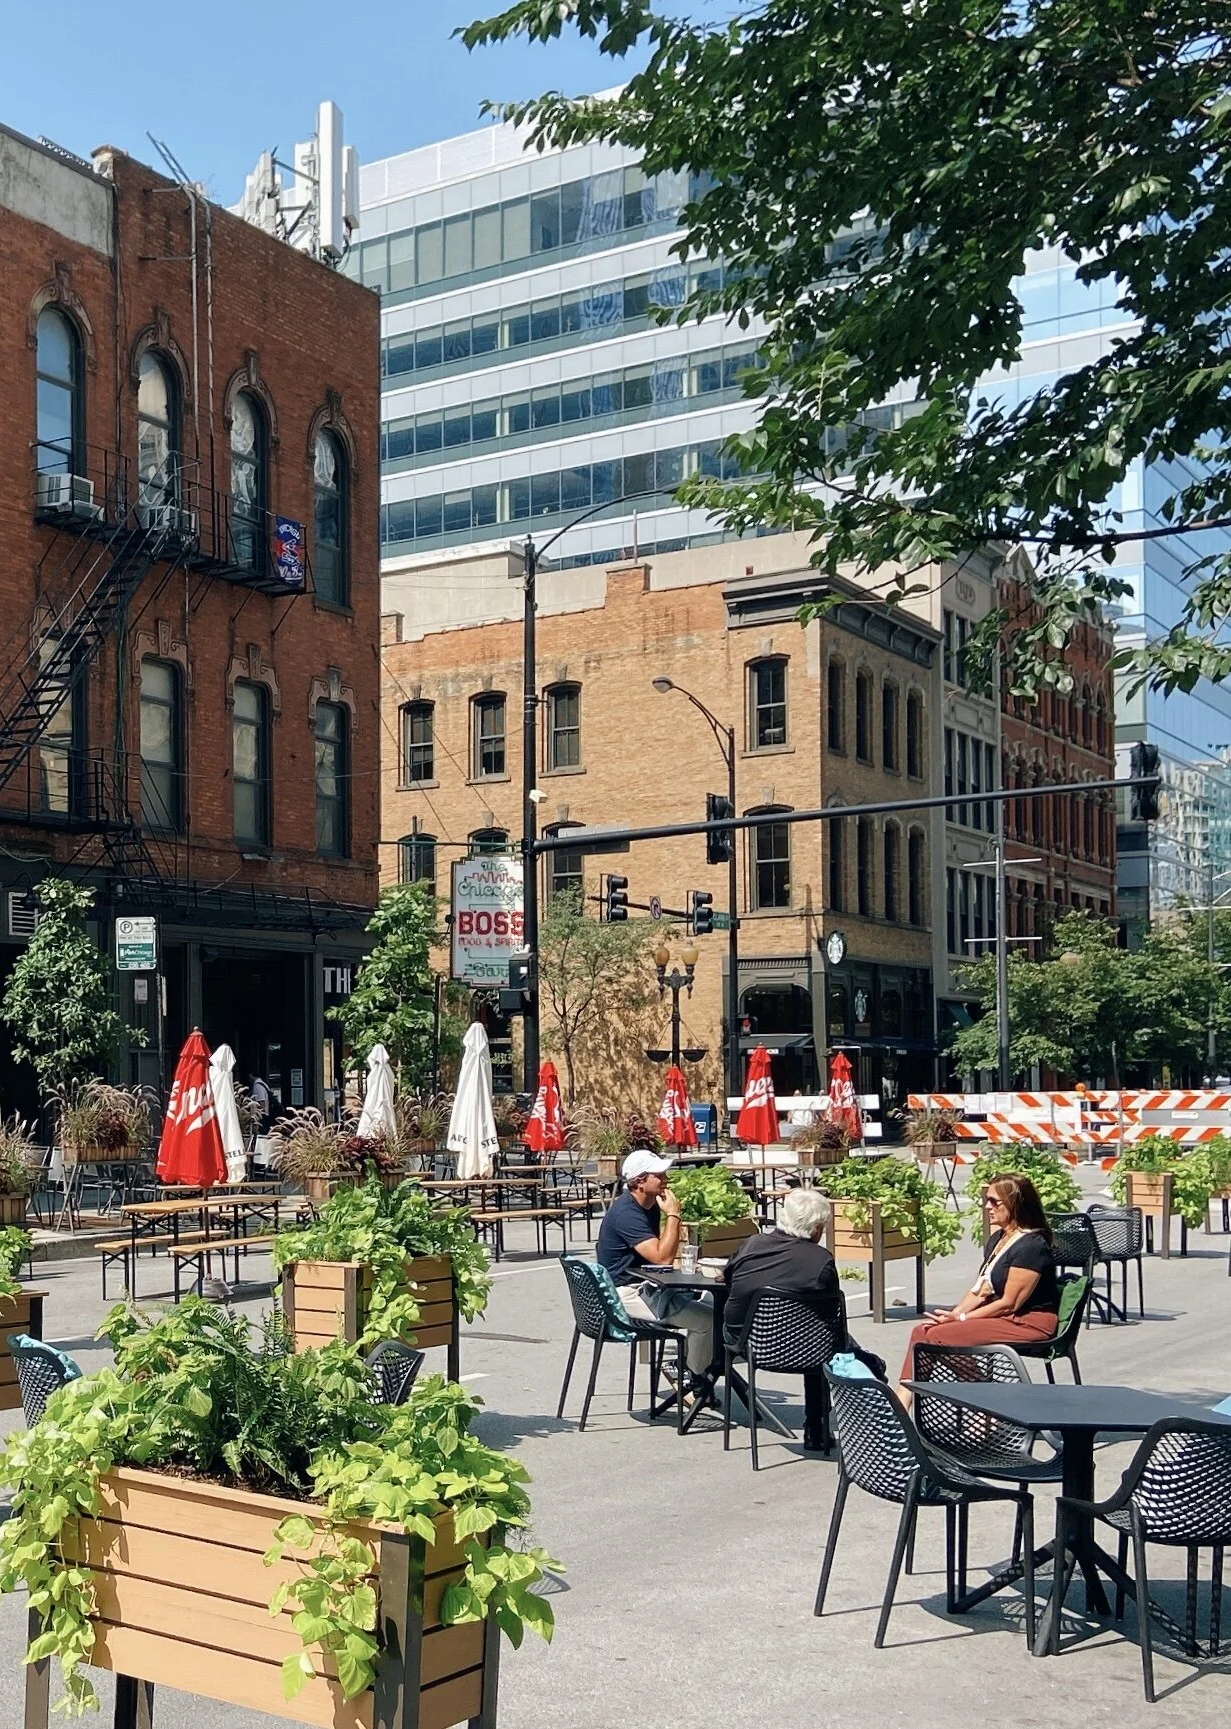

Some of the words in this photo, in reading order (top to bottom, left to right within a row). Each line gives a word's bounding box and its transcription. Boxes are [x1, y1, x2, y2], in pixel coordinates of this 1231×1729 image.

[480, 860, 507, 872] The
[458, 880, 524, 900] Chicago
[459, 910, 524, 936] BOSS
[458, 937, 482, 946] FOOD
